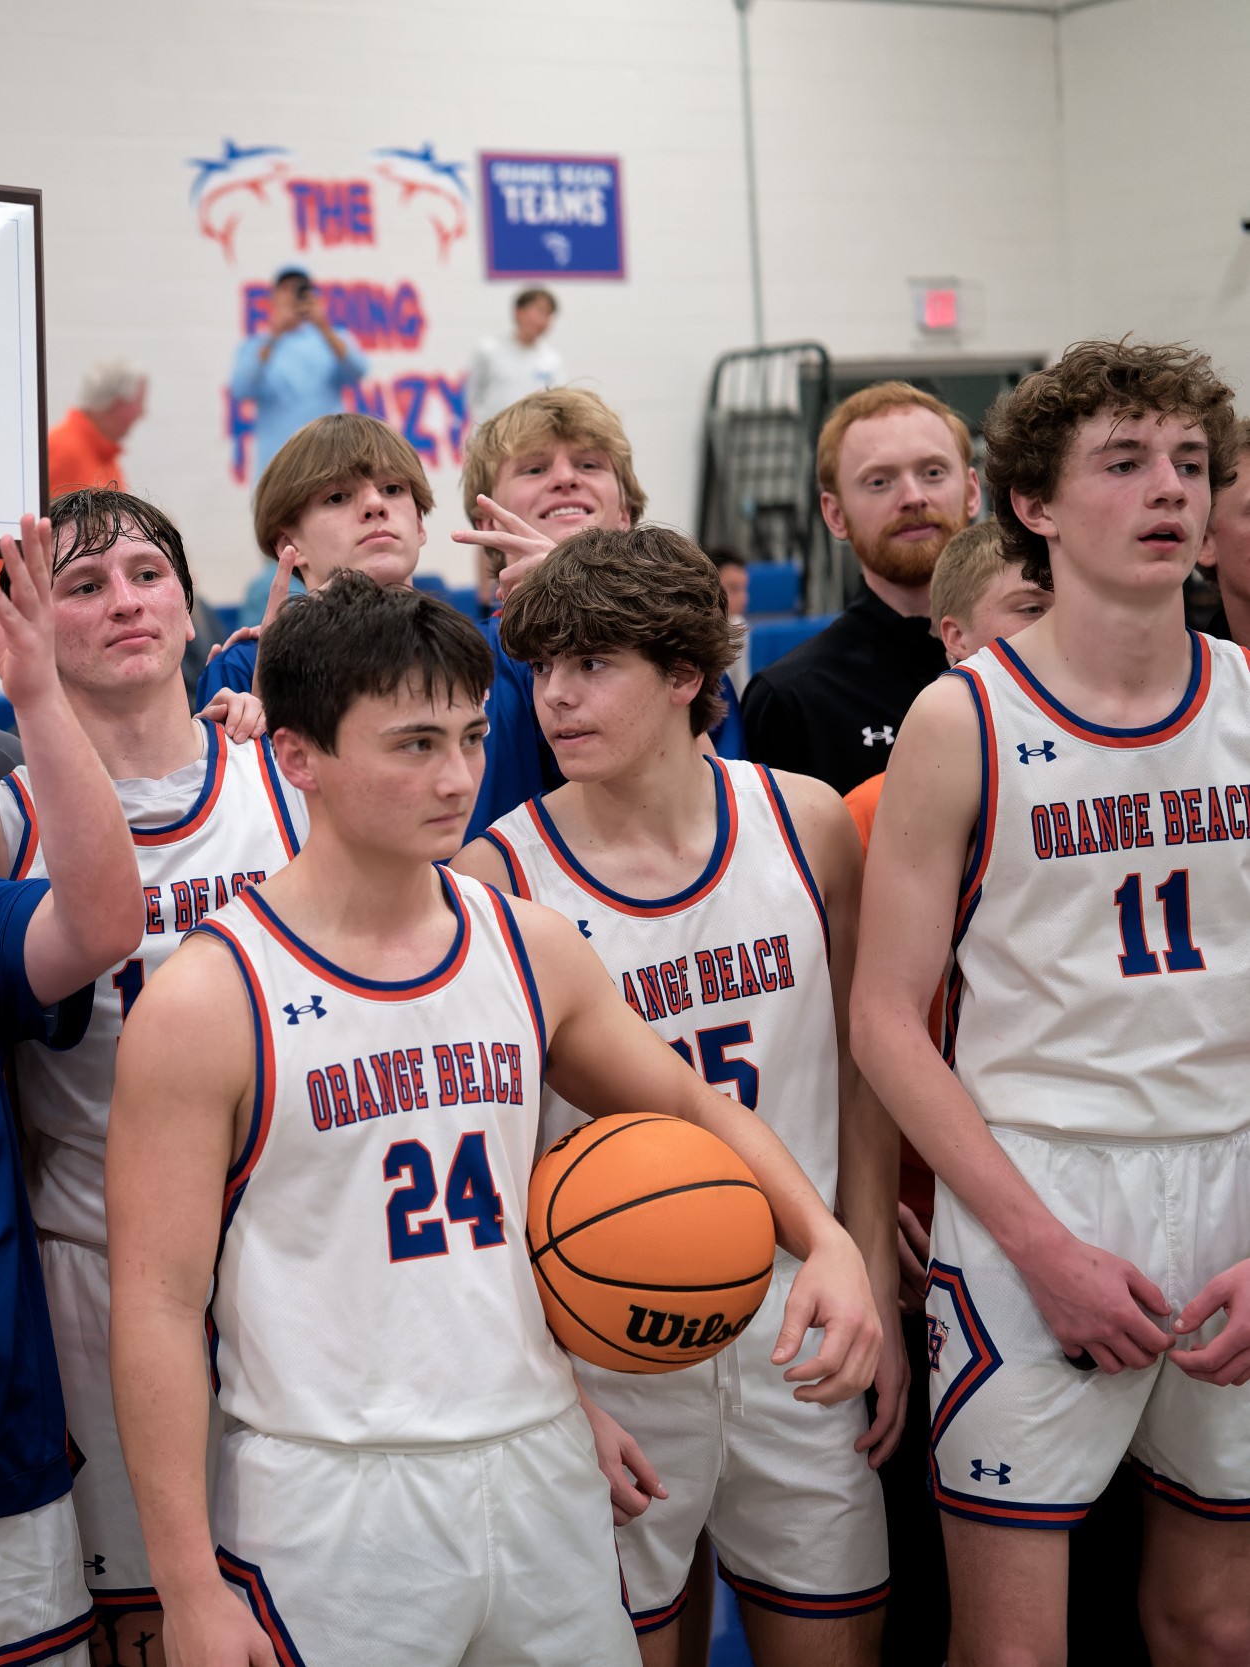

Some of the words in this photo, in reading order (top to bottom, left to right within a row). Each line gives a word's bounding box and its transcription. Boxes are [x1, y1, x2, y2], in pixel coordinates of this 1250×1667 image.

[285, 180, 377, 252] THE
[500, 185, 607, 227] TEAMS
[1031, 793, 1154, 860] ORANGE
[1113, 868, 1207, 979] 11
[622, 956, 693, 1022] ANGE
[694, 934, 795, 1004] BEACH
[306, 1048, 429, 1131] ORANGE
[432, 1042, 523, 1107] BEACH
[667, 1020, 760, 1112] 5
[382, 1130, 507, 1264] 24
[626, 1304, 758, 1348] Wilso
